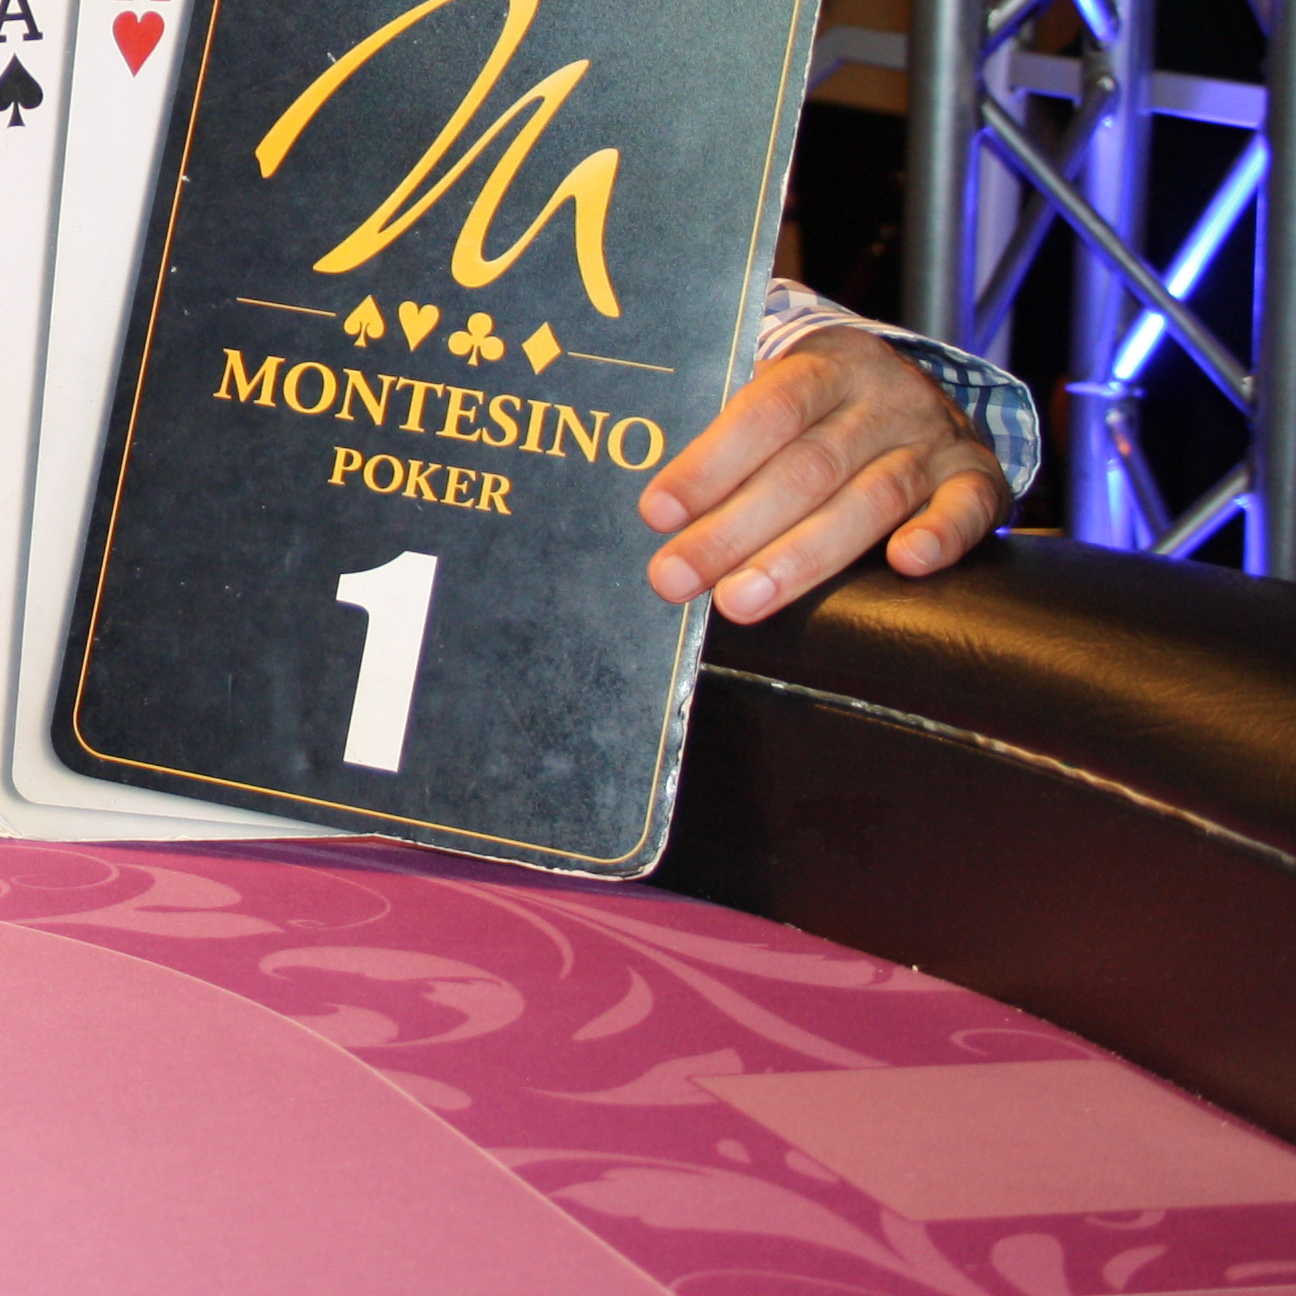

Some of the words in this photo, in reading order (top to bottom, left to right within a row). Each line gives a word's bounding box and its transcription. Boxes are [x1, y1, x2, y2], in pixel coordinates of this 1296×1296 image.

[213, 347, 665, 472] MONTESINO
[328, 447, 512, 516] POKER
[334, 550, 439, 773] 1
